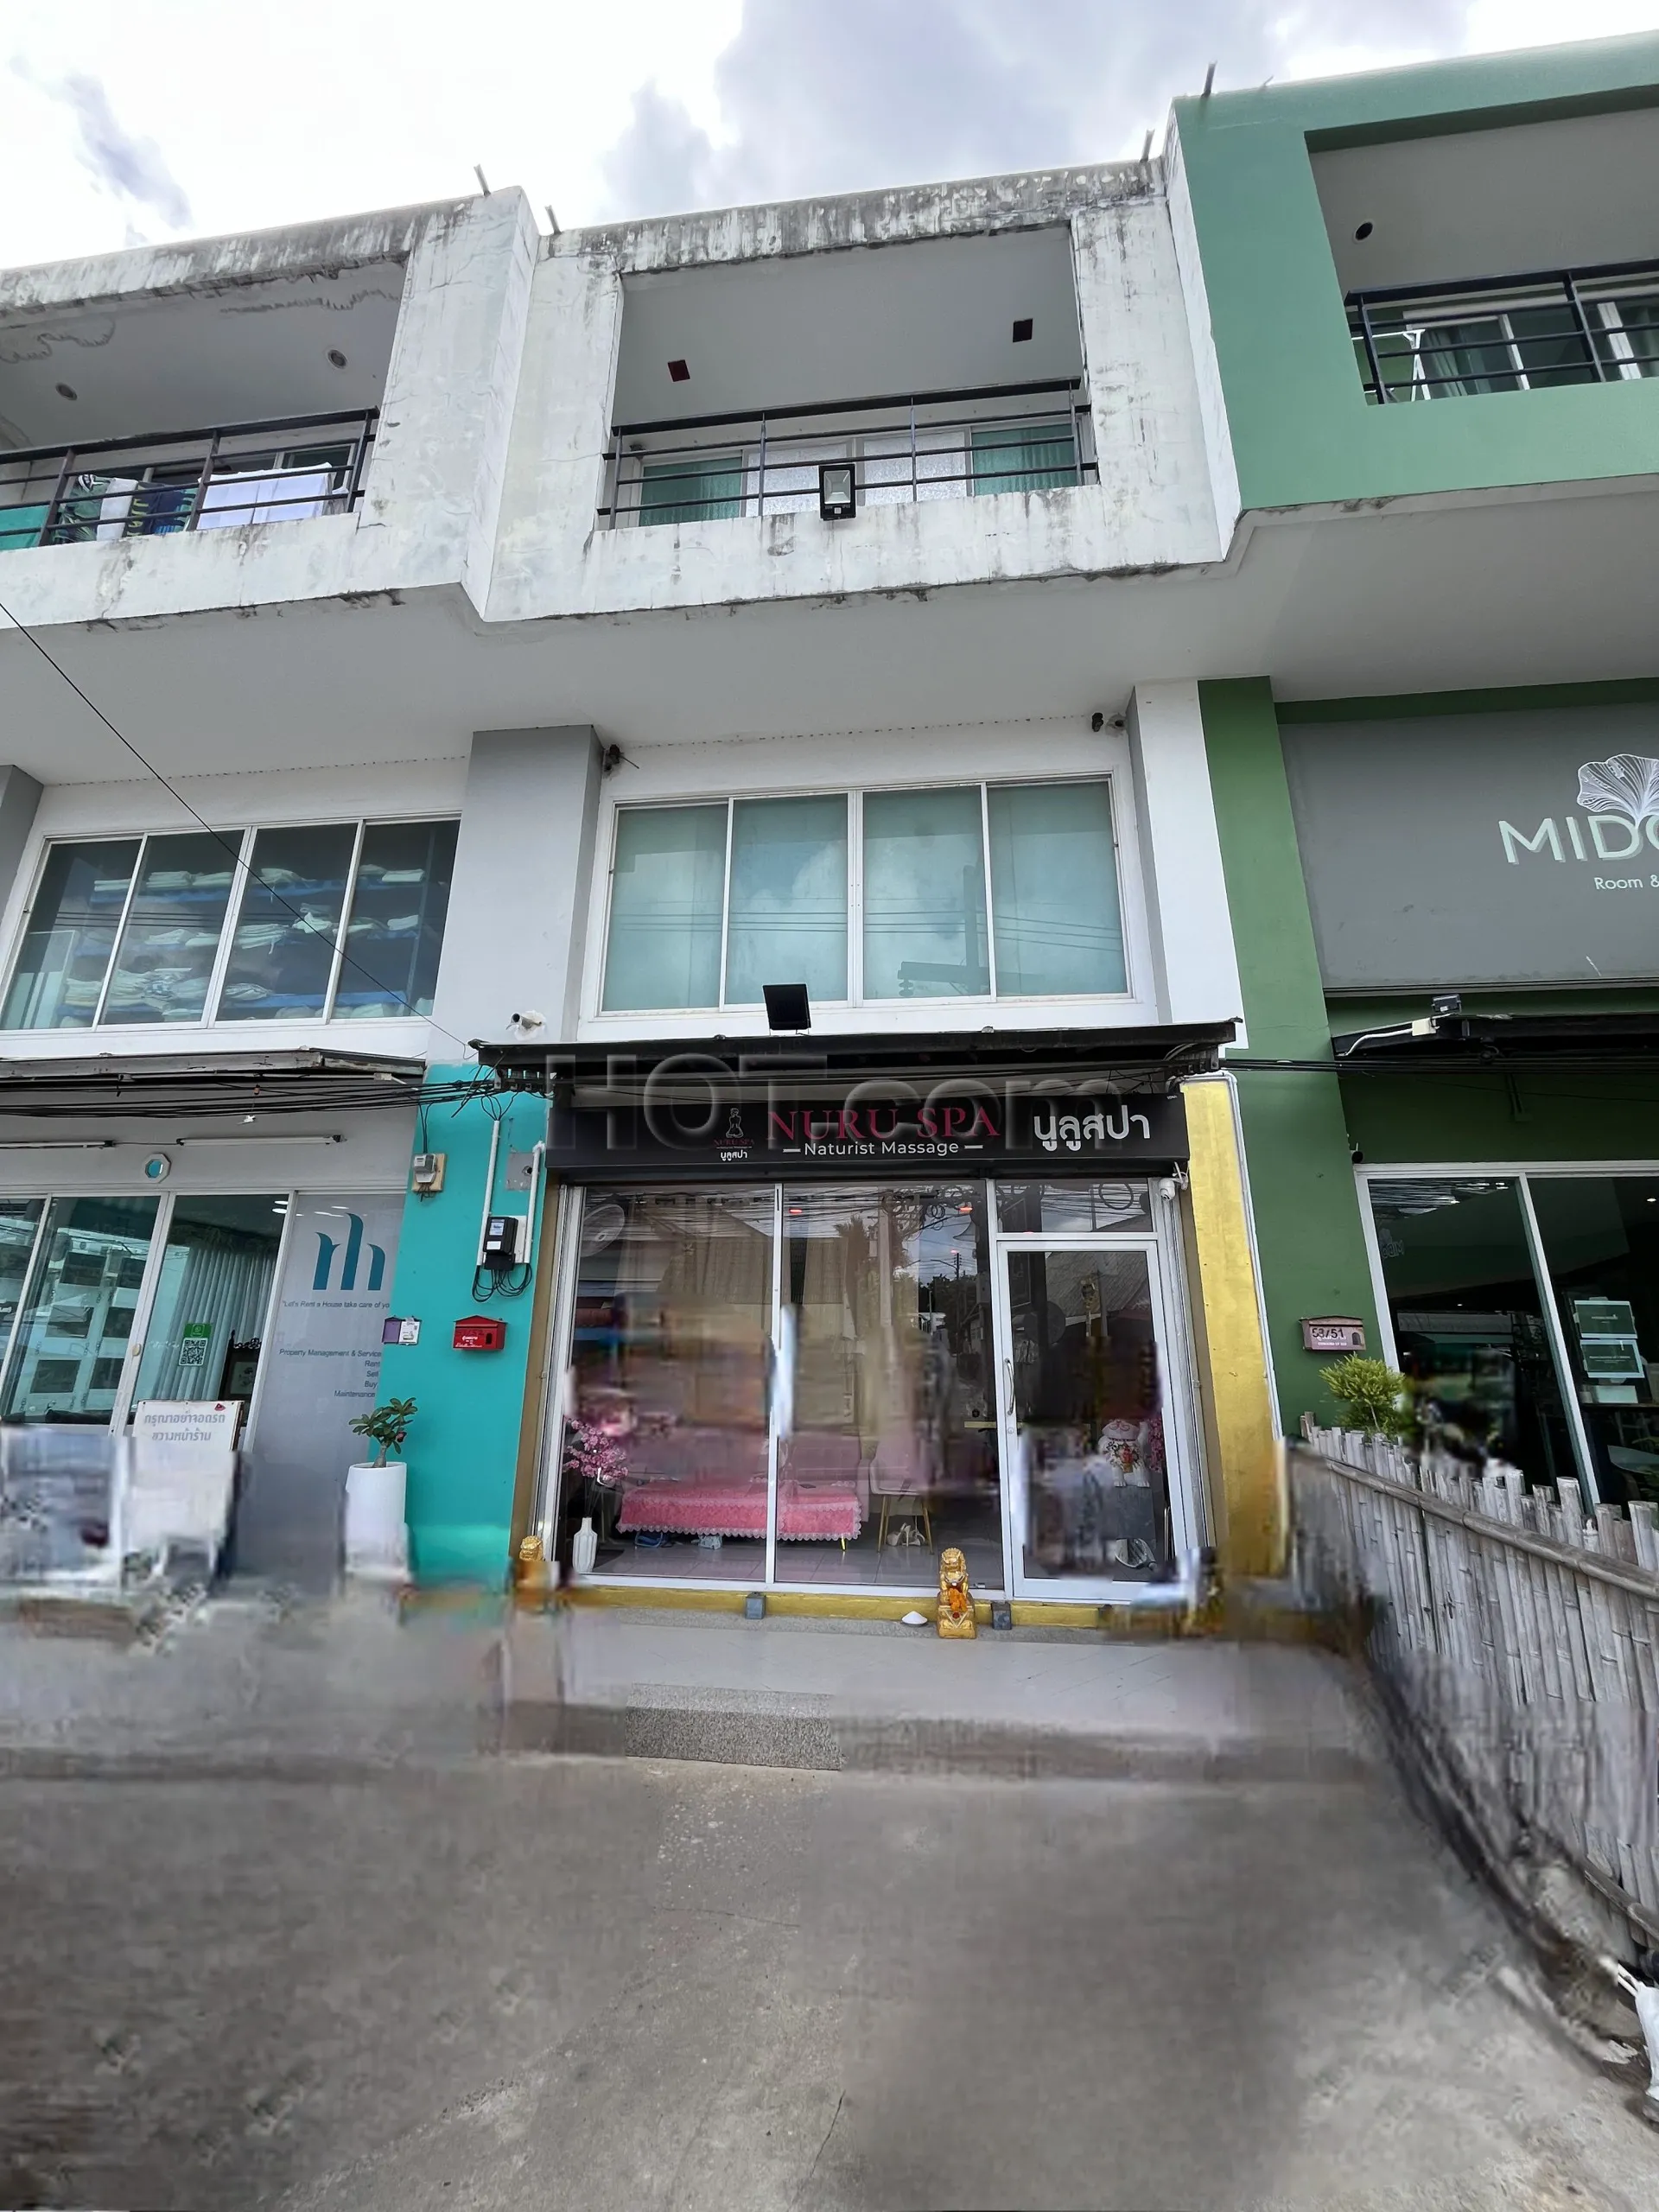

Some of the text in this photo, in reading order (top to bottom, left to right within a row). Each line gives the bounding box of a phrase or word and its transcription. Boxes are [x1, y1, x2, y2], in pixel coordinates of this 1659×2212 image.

[1498, 814, 1659, 865] MID
[1593, 876, 1643, 890] Room
[766, 1105, 1001, 1141] NURU SPA
[1033, 1104, 1151, 1152] นูลูสปา
[804, 1141, 959, 1156] Naturist Massage
[279, 1348, 306, 1357] Property
[308, 1349, 350, 1357] Management
